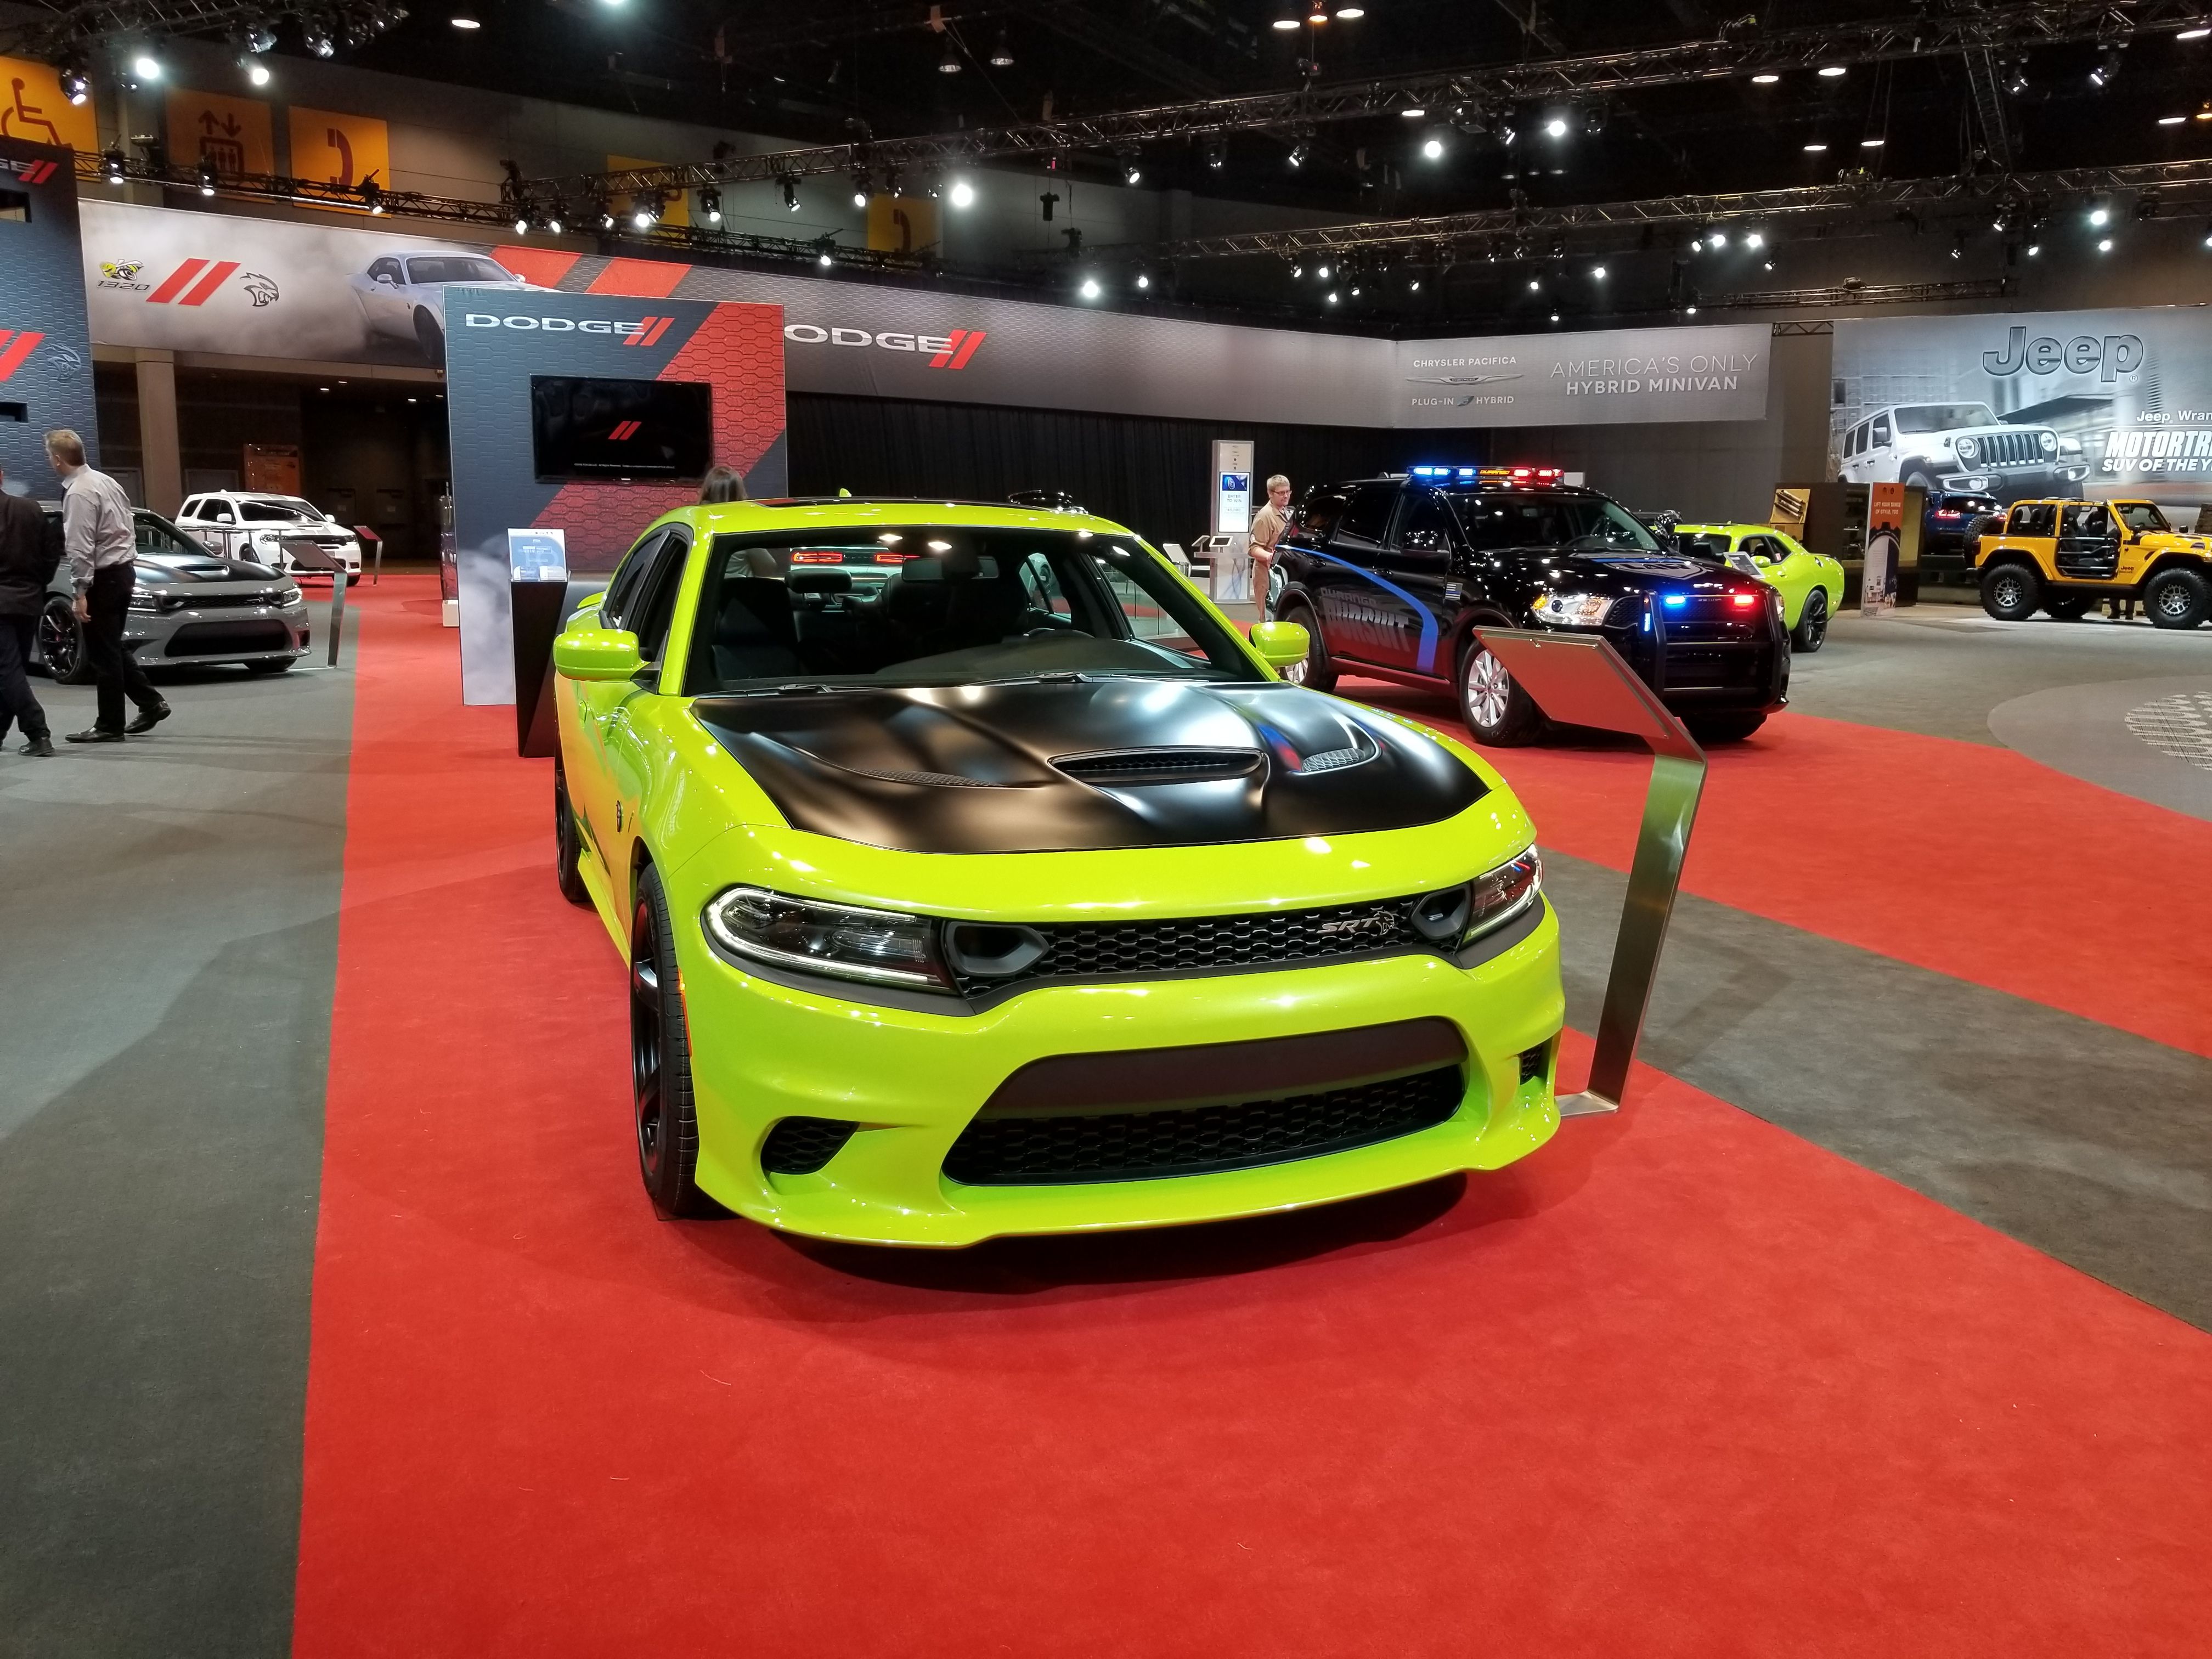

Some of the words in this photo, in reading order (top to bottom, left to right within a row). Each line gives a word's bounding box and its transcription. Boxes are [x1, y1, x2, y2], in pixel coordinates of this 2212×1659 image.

[97, 280, 150, 291] 1320
[466, 314, 645, 335] DODGE
[784, 324, 953, 354] ODGE
[1413, 359, 1465, 368] CHRYSLER
[1469, 356, 1516, 365] PACIFICA
[1983, 326, 2143, 382] Jeep
[1550, 356, 1679, 378] AMERICA'S
[1690, 353, 1758, 373] ONLY
[1566, 379, 1641, 395] HYBRID
[1649, 376, 1738, 392] MINIVAN
[1412, 397, 1454, 406] PLUG-IN
[1476, 396, 1514, 404] HYBRID
[2136, 410, 2171, 424] Jeep
[2104, 431, 2212, 458] MOTORTR
[2102, 459, 2137, 472] SUV
[2138, 459, 2164, 472] OF
[2166, 459, 2199, 472] THE
[1320, 587, 1377, 607] DURANGO
[1317, 917, 1380, 933] SRT
